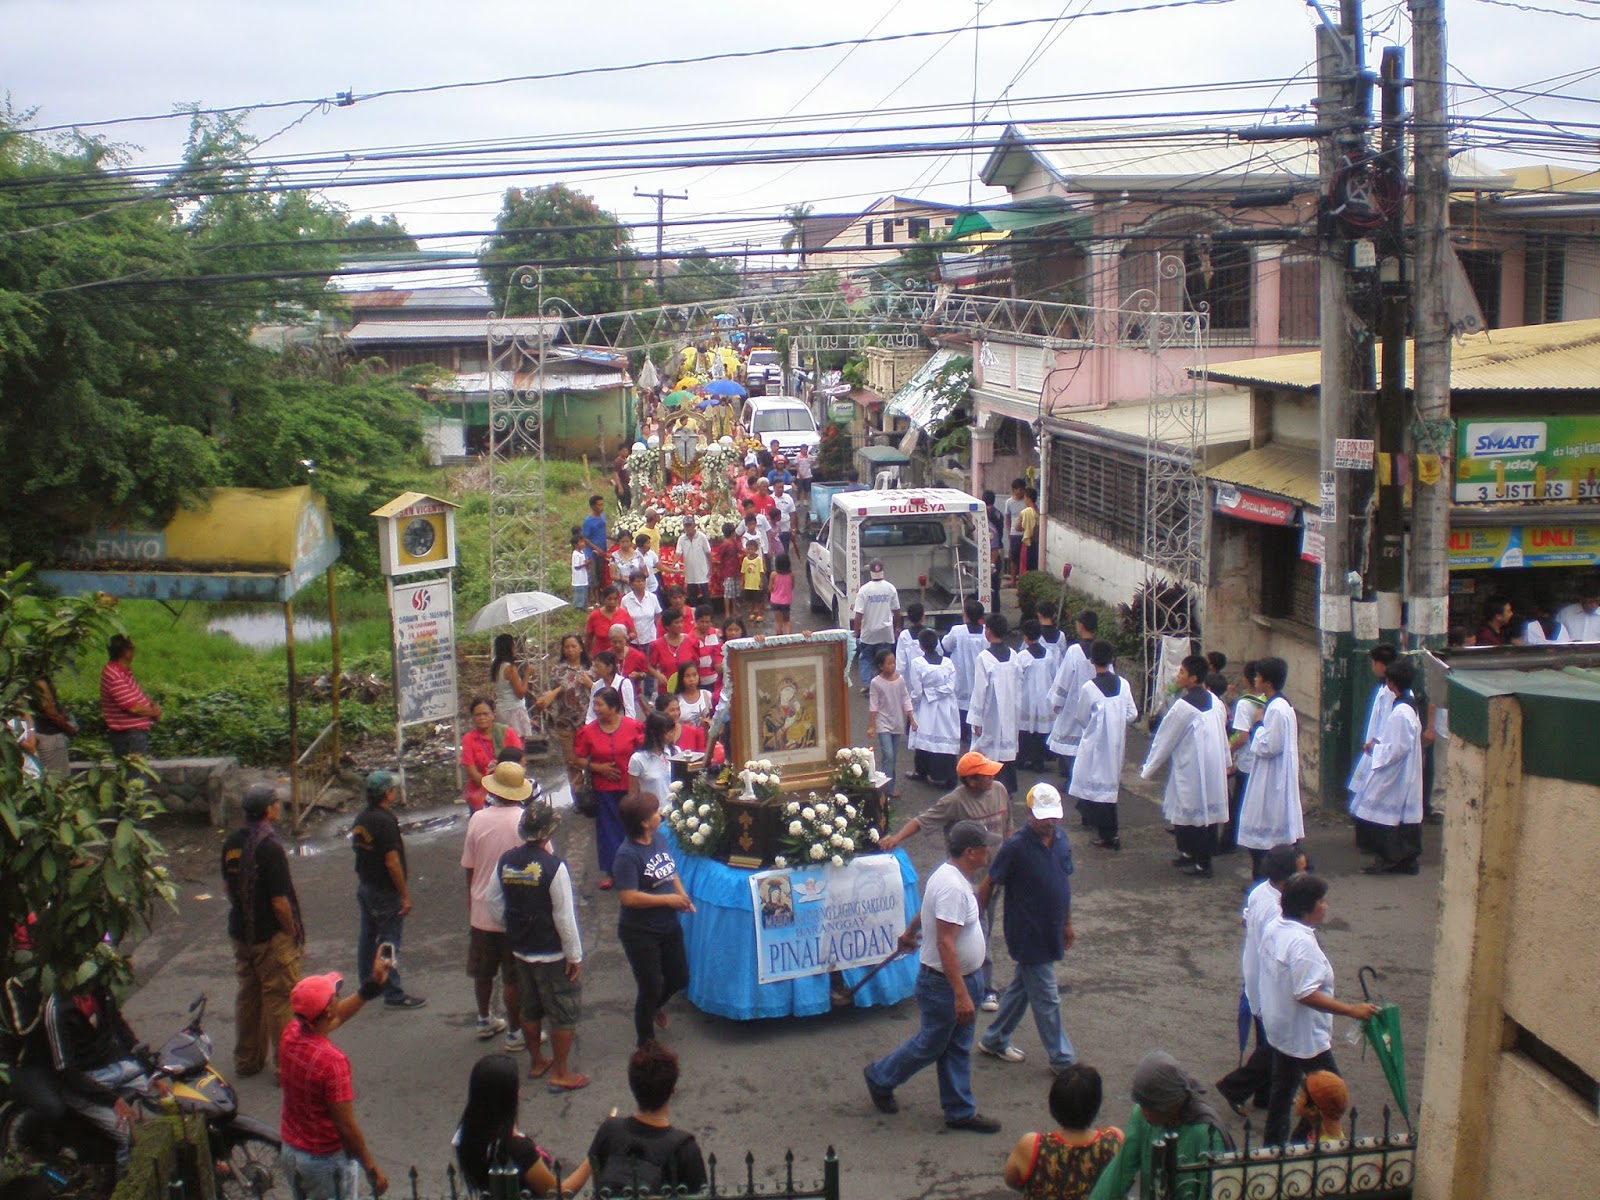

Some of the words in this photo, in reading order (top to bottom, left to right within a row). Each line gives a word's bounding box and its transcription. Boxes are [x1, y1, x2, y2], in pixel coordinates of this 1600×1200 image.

[848, 335, 867, 350] PO
[877, 334, 916, 349] KAYO
[1475, 433, 1540, 451] SMART
[1479, 487, 1489, 500] 3
[889, 503, 946, 513] PULISYA
[981, 515, 989, 564] BULACAN
[1532, 528, 1575, 547] UNLI
[850, 523, 858, 580] PAOMBONG
[980, 594, 991, 605] 463
[644, 853, 662, 877] POLO
[796, 917, 867, 938] BARANGGAY
[769, 923, 894, 974] PINALAGDAN
